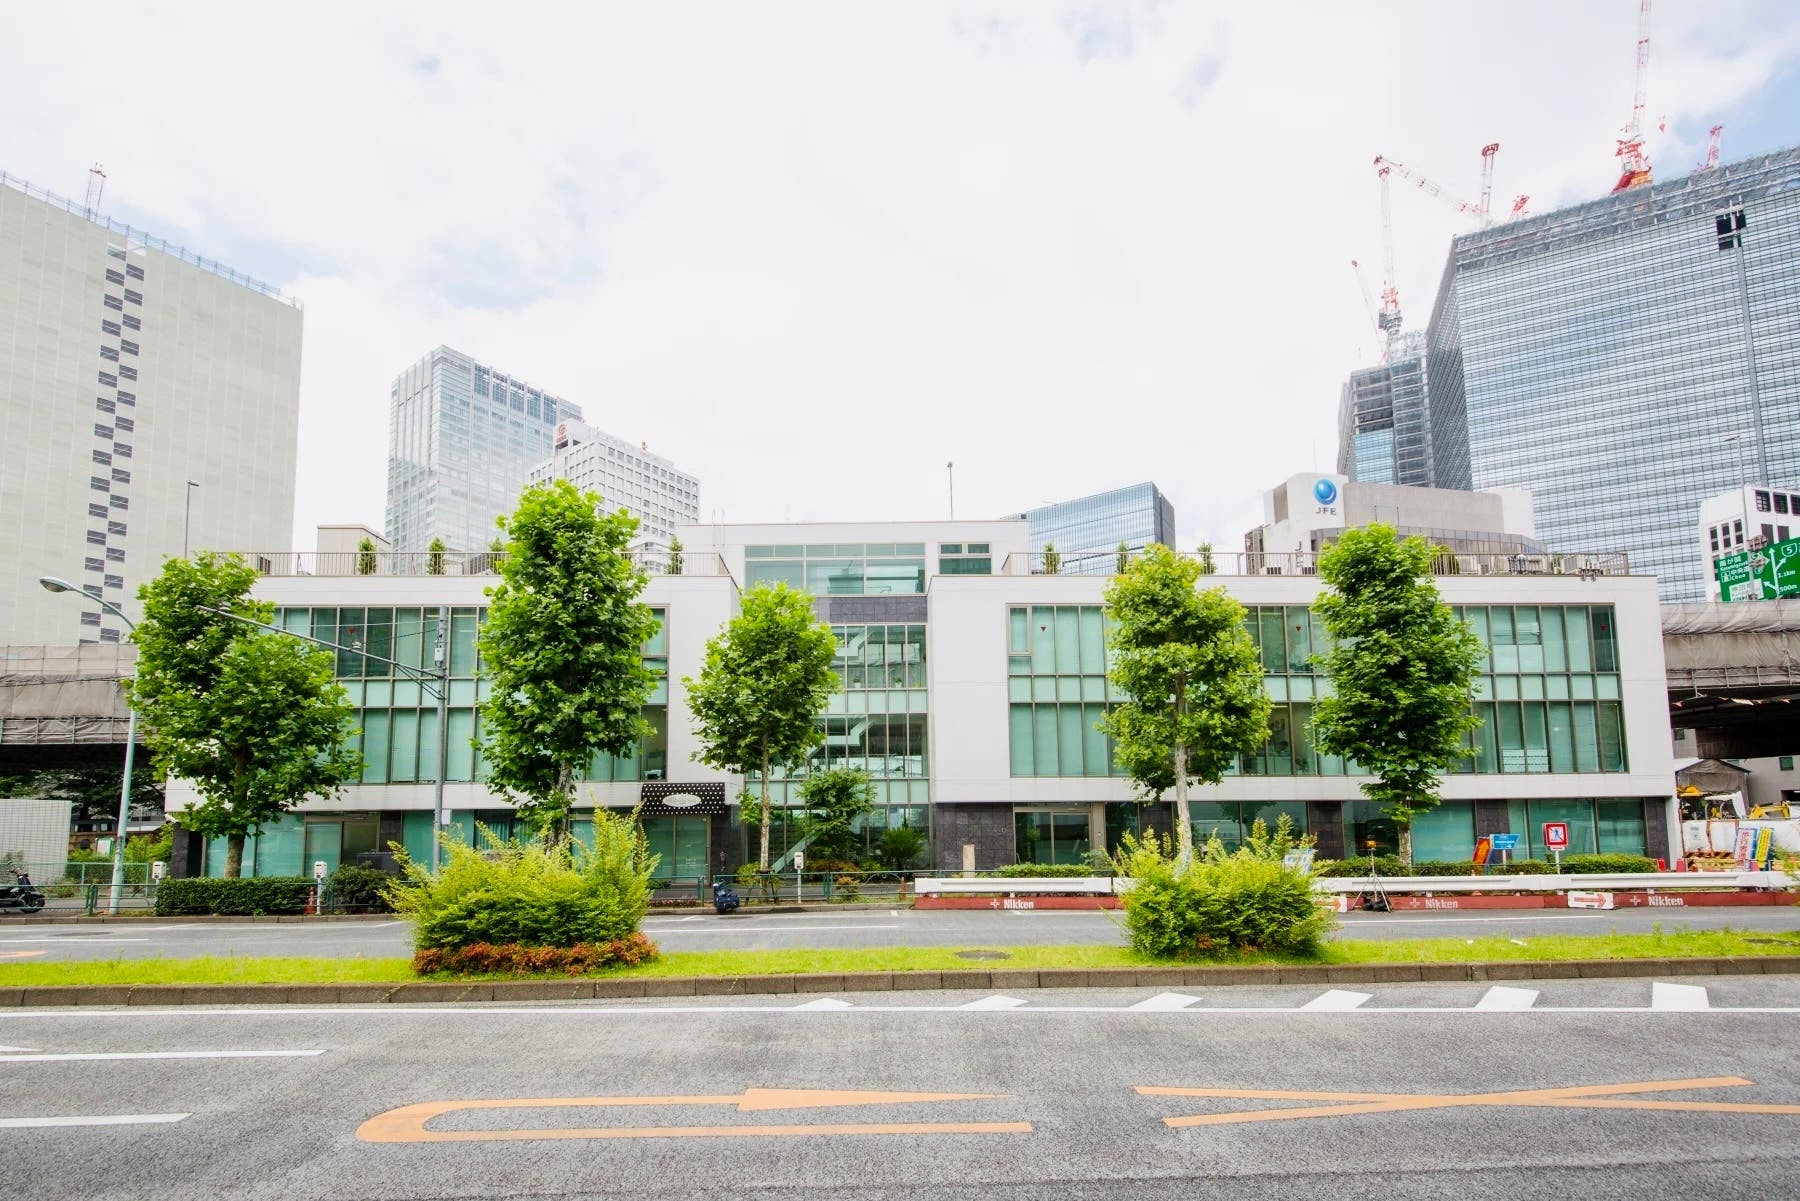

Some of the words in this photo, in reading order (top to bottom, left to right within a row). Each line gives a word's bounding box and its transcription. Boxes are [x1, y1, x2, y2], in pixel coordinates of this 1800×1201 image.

[1315, 506, 1337, 516] JFE
[1786, 546, 1793, 554] 5
[1779, 584, 1798, 592] 500m
[1003, 899, 1034, 909] Nikken
[1425, 898, 1458, 909] Nikken
[1648, 895, 1684, 906] Nikken
